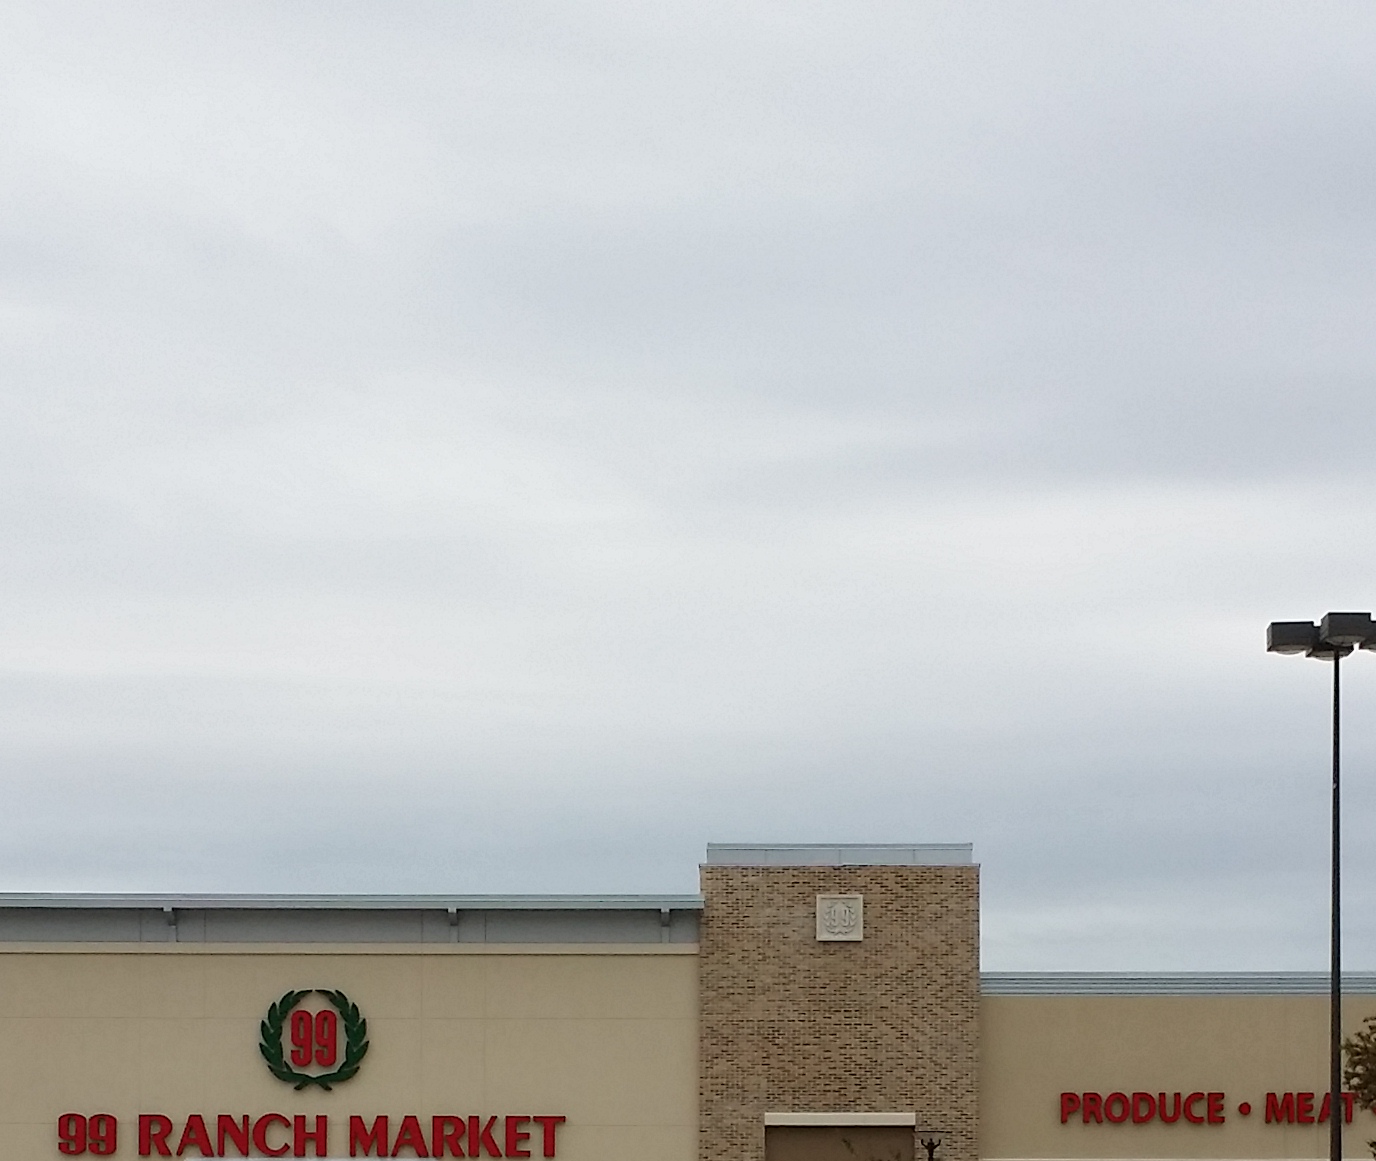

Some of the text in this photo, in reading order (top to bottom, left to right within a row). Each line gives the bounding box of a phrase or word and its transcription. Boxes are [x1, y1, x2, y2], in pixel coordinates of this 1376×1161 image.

[291, 1010, 337, 1067] 99
[1060, 1092, 1225, 1124] PRODUCE
[57, 1113, 566, 1158] 99 RANCH MARKET
